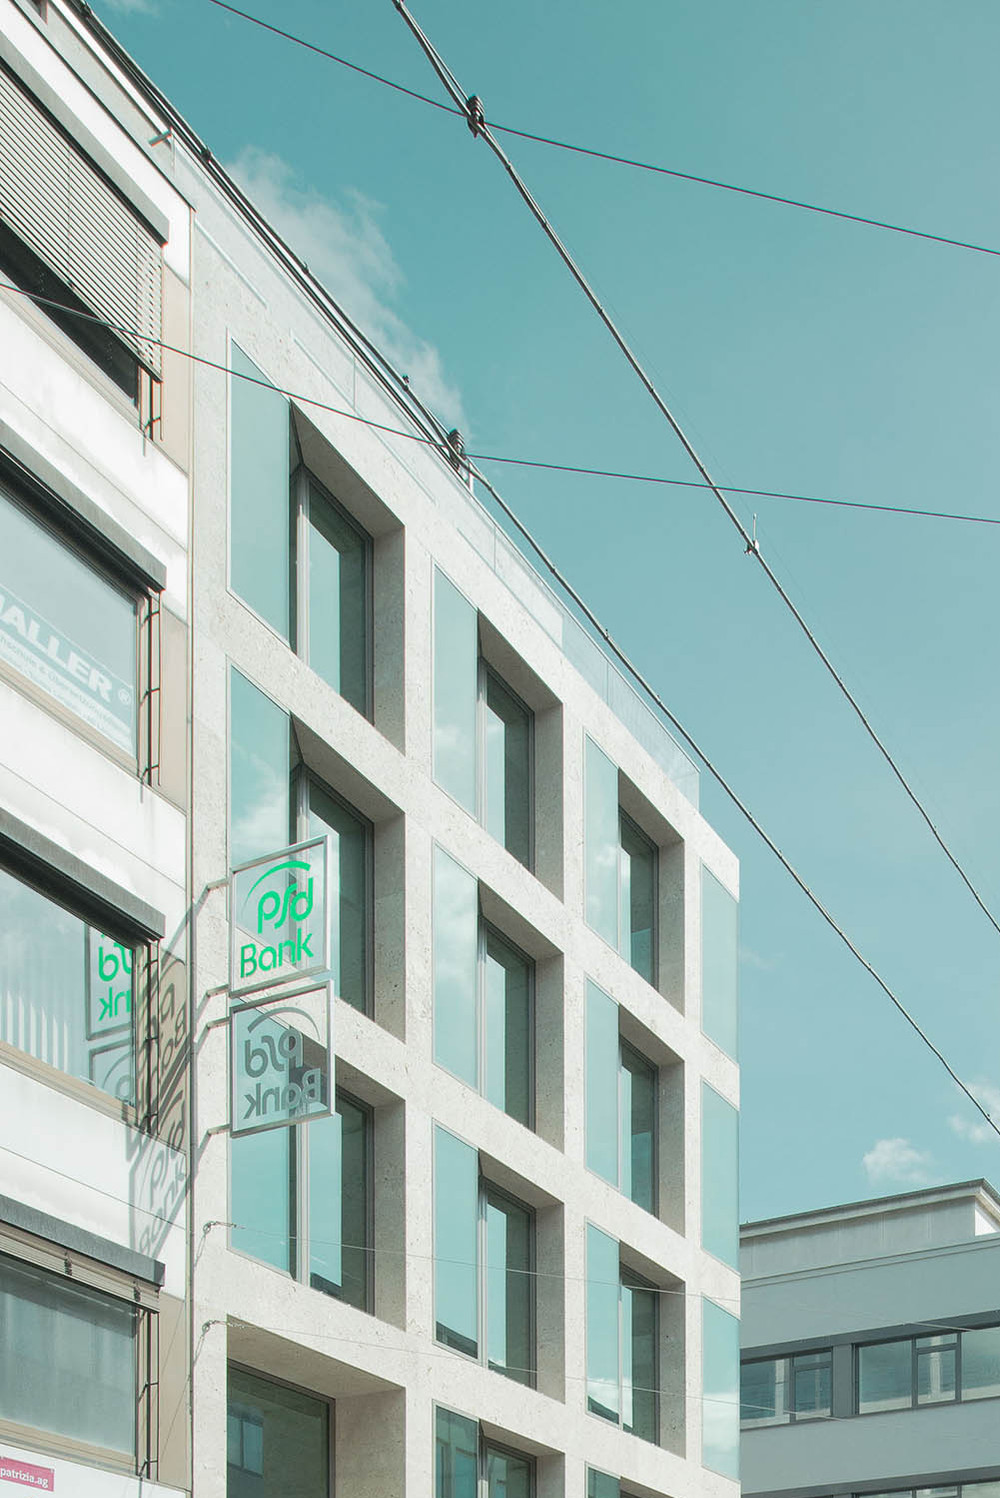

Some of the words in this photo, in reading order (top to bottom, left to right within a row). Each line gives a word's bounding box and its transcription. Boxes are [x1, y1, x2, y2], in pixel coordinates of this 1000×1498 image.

[0, 597, 112, 702] ALLER
[257, 876, 314, 934] psd
[240, 928, 314, 979] Bank
[0, 1467, 49, 1489] patrizia.ag
